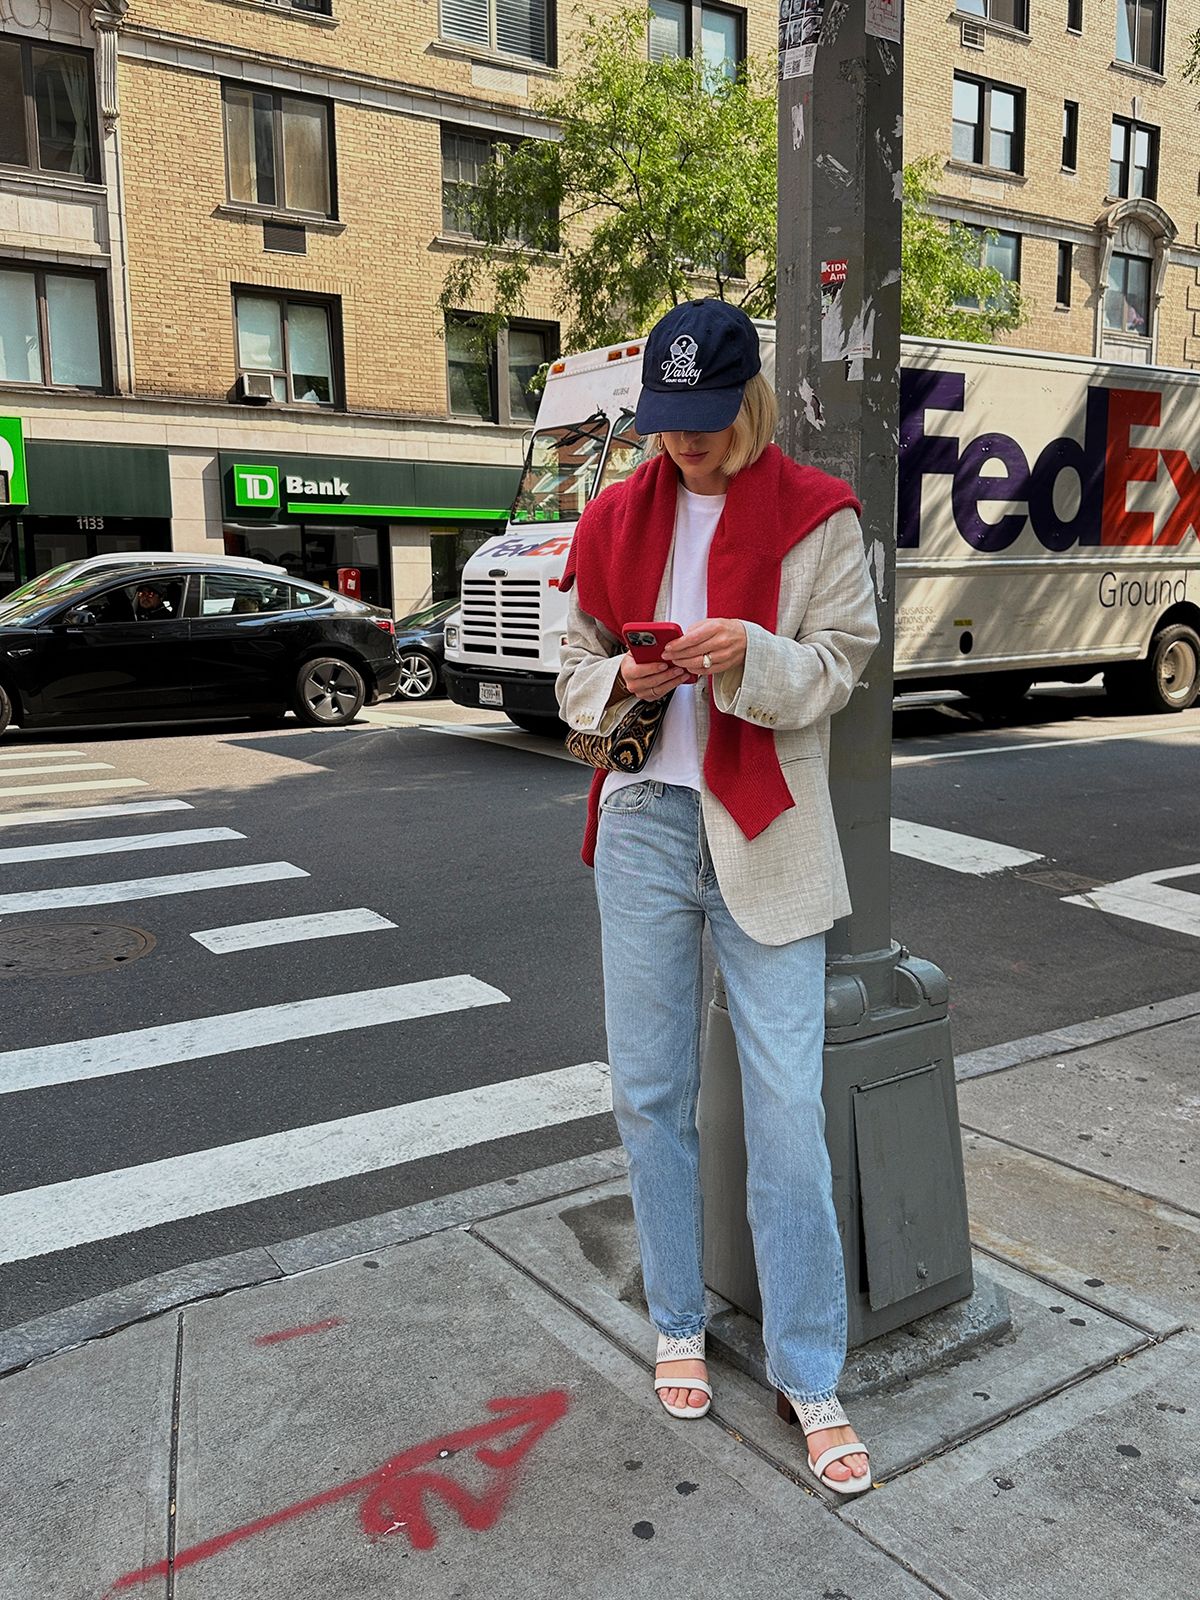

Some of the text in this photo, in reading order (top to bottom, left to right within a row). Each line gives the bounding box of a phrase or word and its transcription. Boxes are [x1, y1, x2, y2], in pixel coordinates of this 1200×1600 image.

[660, 359, 703, 386] Varley
[896, 367, 1200, 553] FedEx
[239, 473, 351, 500] TD Bank
[77, 518, 105, 530] 1133
[1098, 569, 1188, 608] Ground
